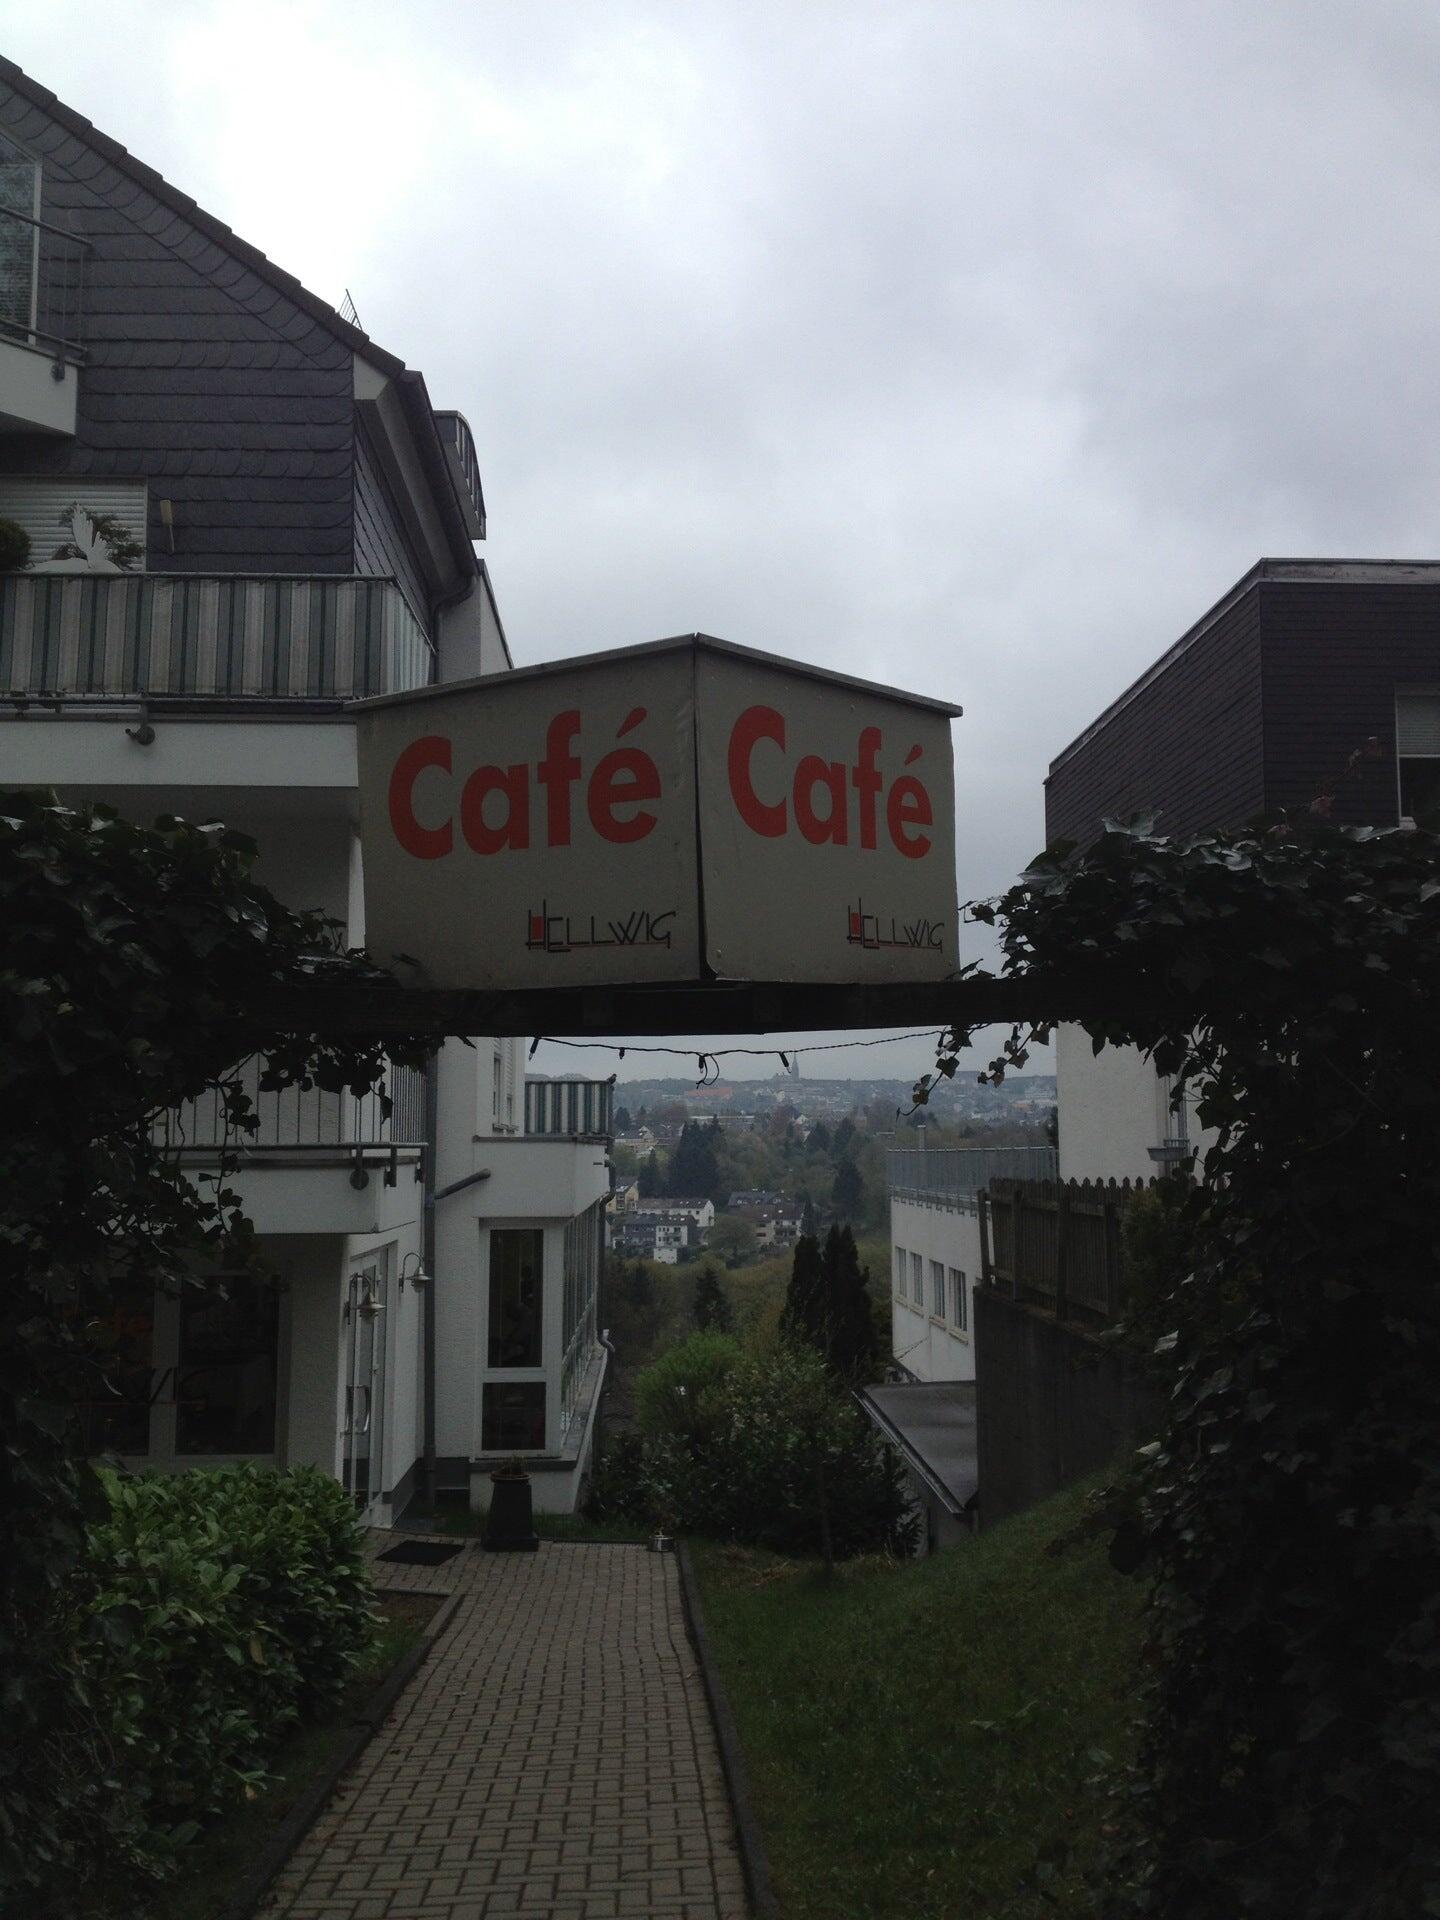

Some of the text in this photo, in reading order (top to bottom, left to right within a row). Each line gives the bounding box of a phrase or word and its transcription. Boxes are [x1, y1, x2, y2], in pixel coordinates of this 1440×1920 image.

[388, 706, 662, 860] Café
[728, 705, 933, 859] Café
[526, 899, 677, 953] HELLWIG
[847, 897, 945, 954] HELLWIG
